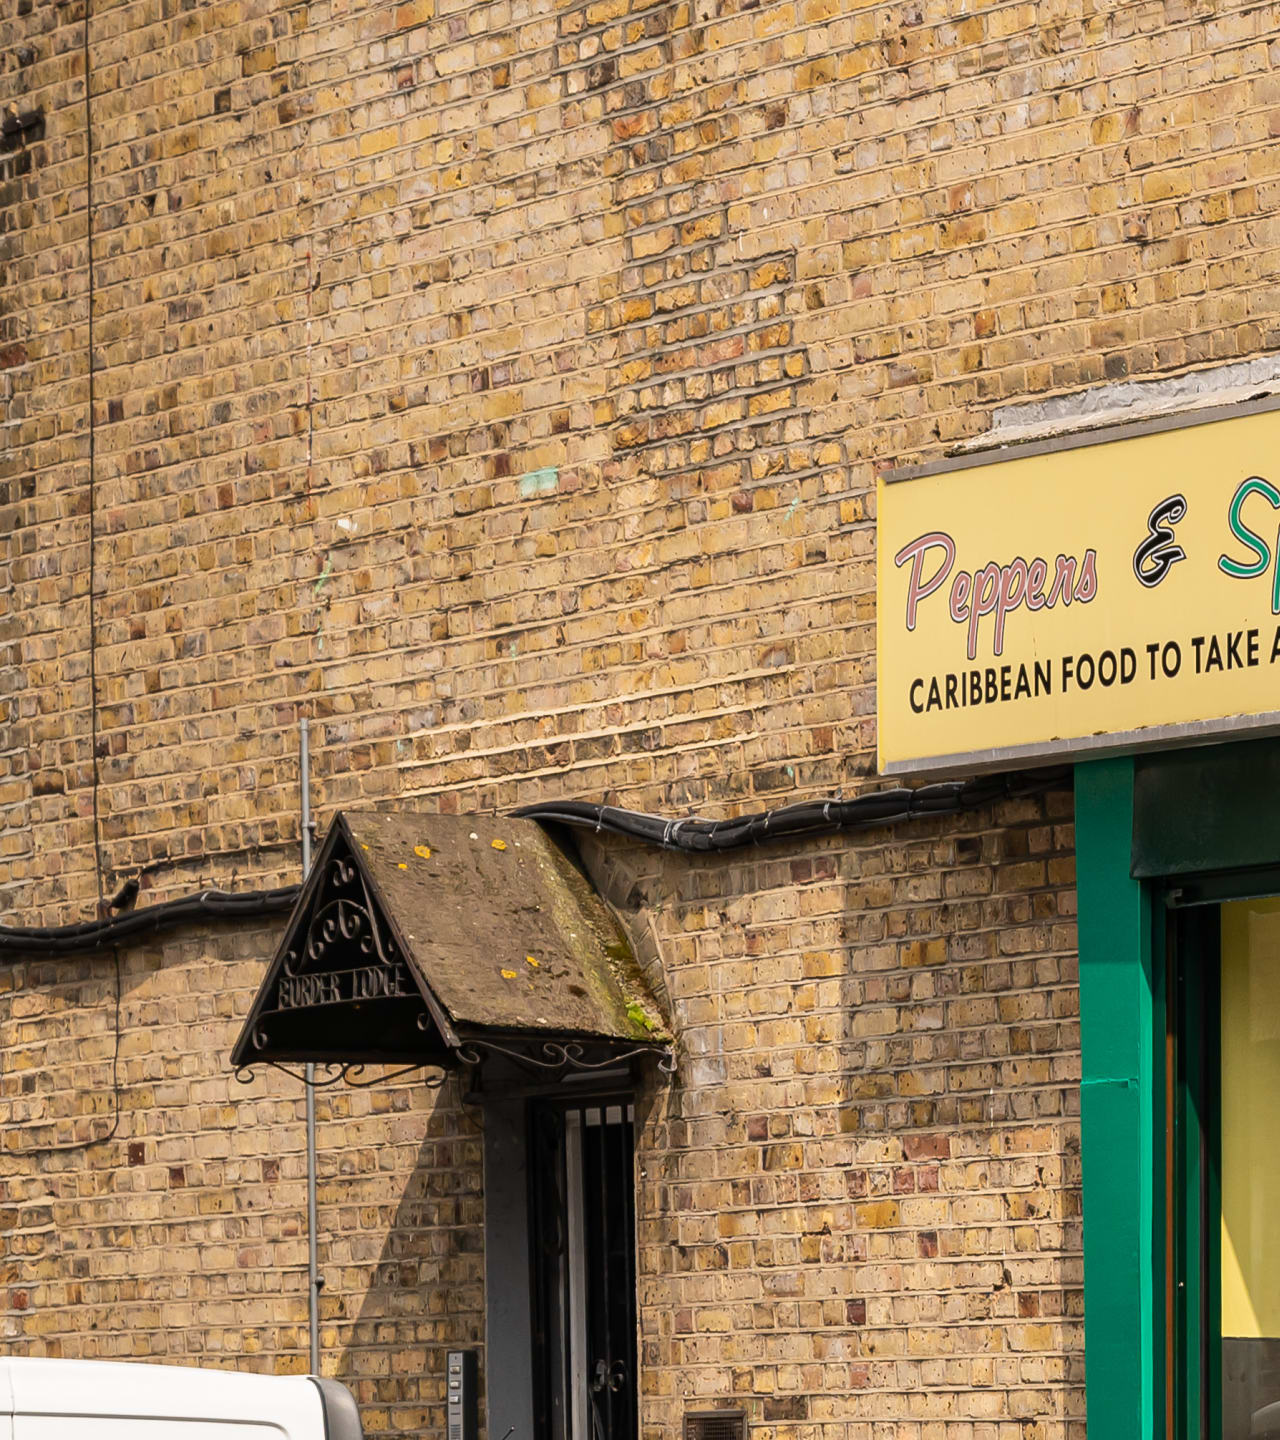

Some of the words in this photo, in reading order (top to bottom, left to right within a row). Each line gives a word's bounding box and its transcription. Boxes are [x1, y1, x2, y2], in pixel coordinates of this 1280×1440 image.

[894, 531, 1098, 661] Peppers
[1132, 493, 1187, 589] &
[909, 658, 1053, 715] CARIBBEAN
[1061, 646, 1136, 695] FOOD
[1146, 640, 1182, 680] TO
[1191, 628, 1260, 675] TAKE
[278, 972, 340, 1010] BURDER
[353, 963, 405, 999] LODGE
